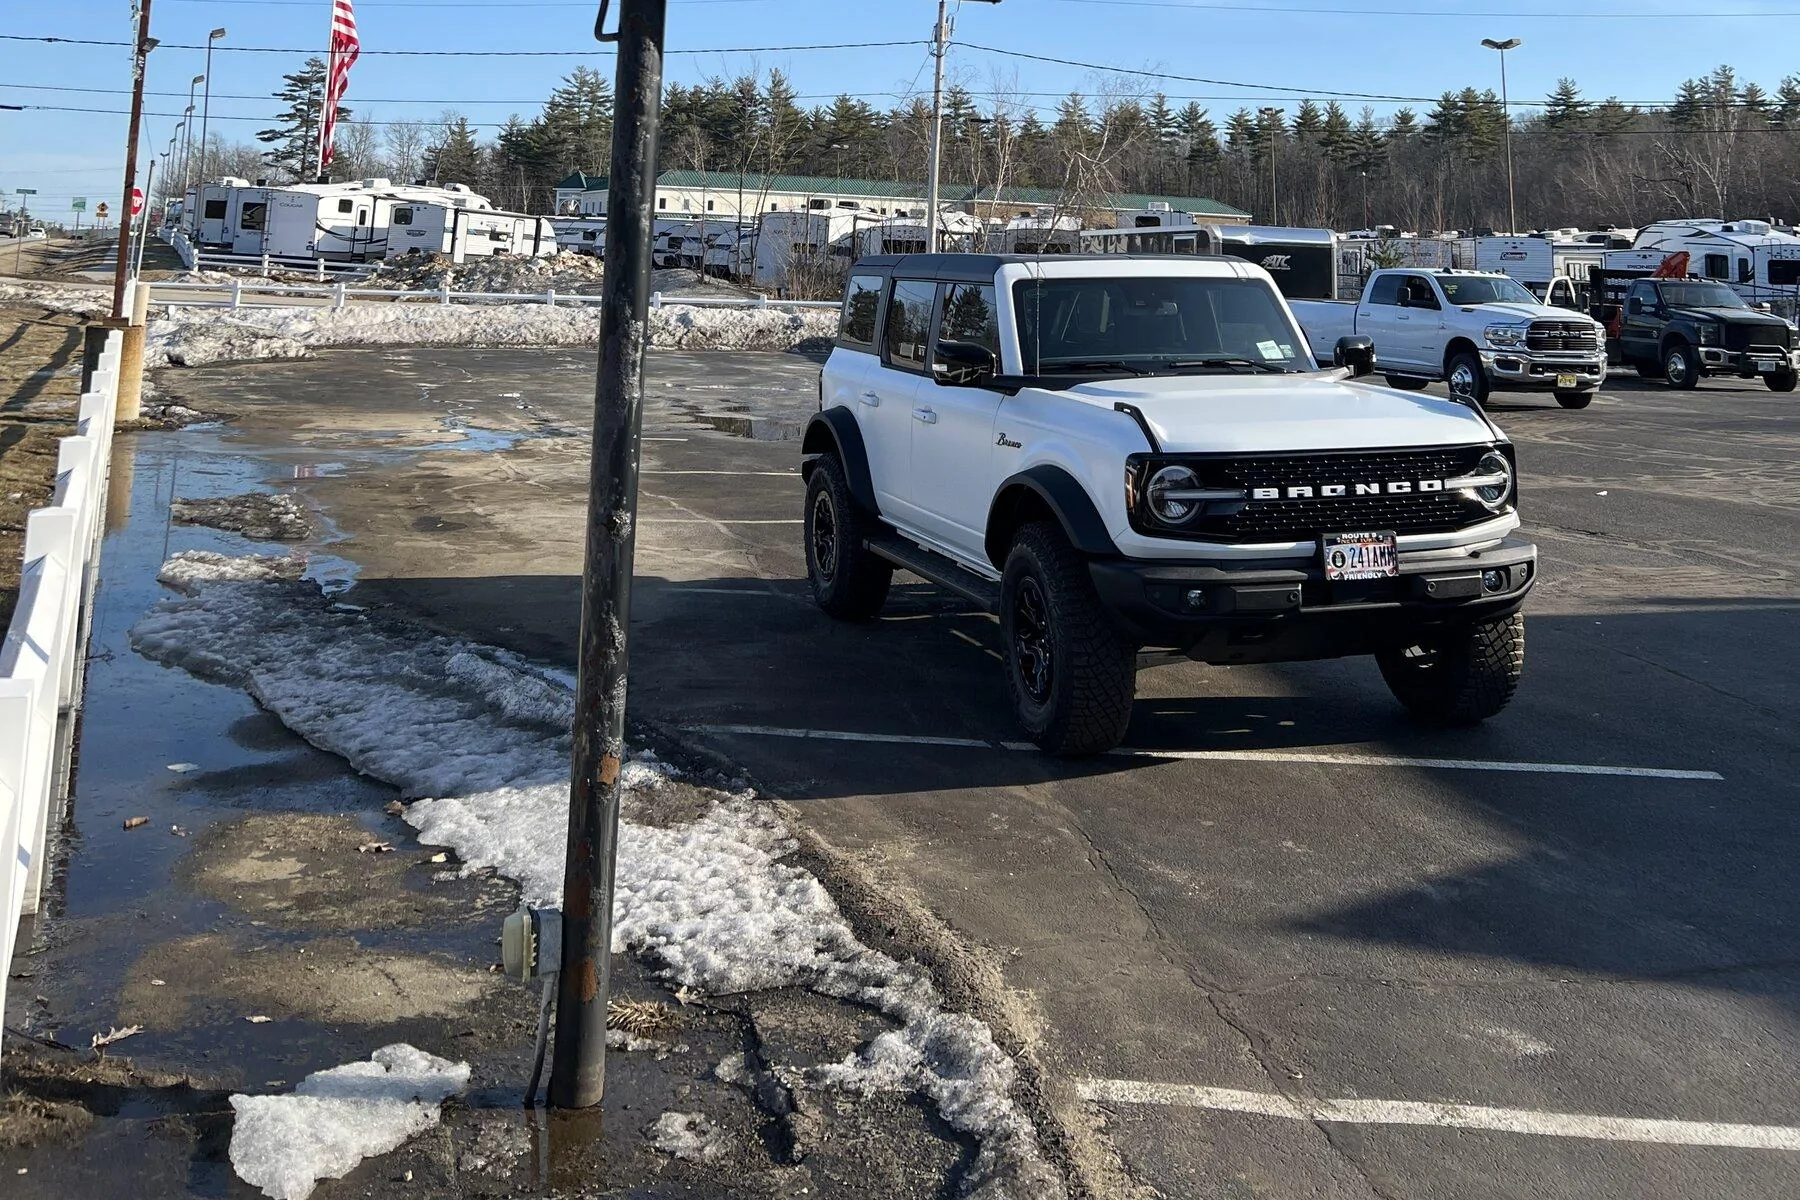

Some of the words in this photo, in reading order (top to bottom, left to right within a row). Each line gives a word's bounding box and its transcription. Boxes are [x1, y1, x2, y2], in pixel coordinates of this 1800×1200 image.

[1253, 480, 1442, 499] BRONCO
[1341, 532, 1370, 540] ROUTE
[1344, 571, 1382, 581] FRIENDLY
